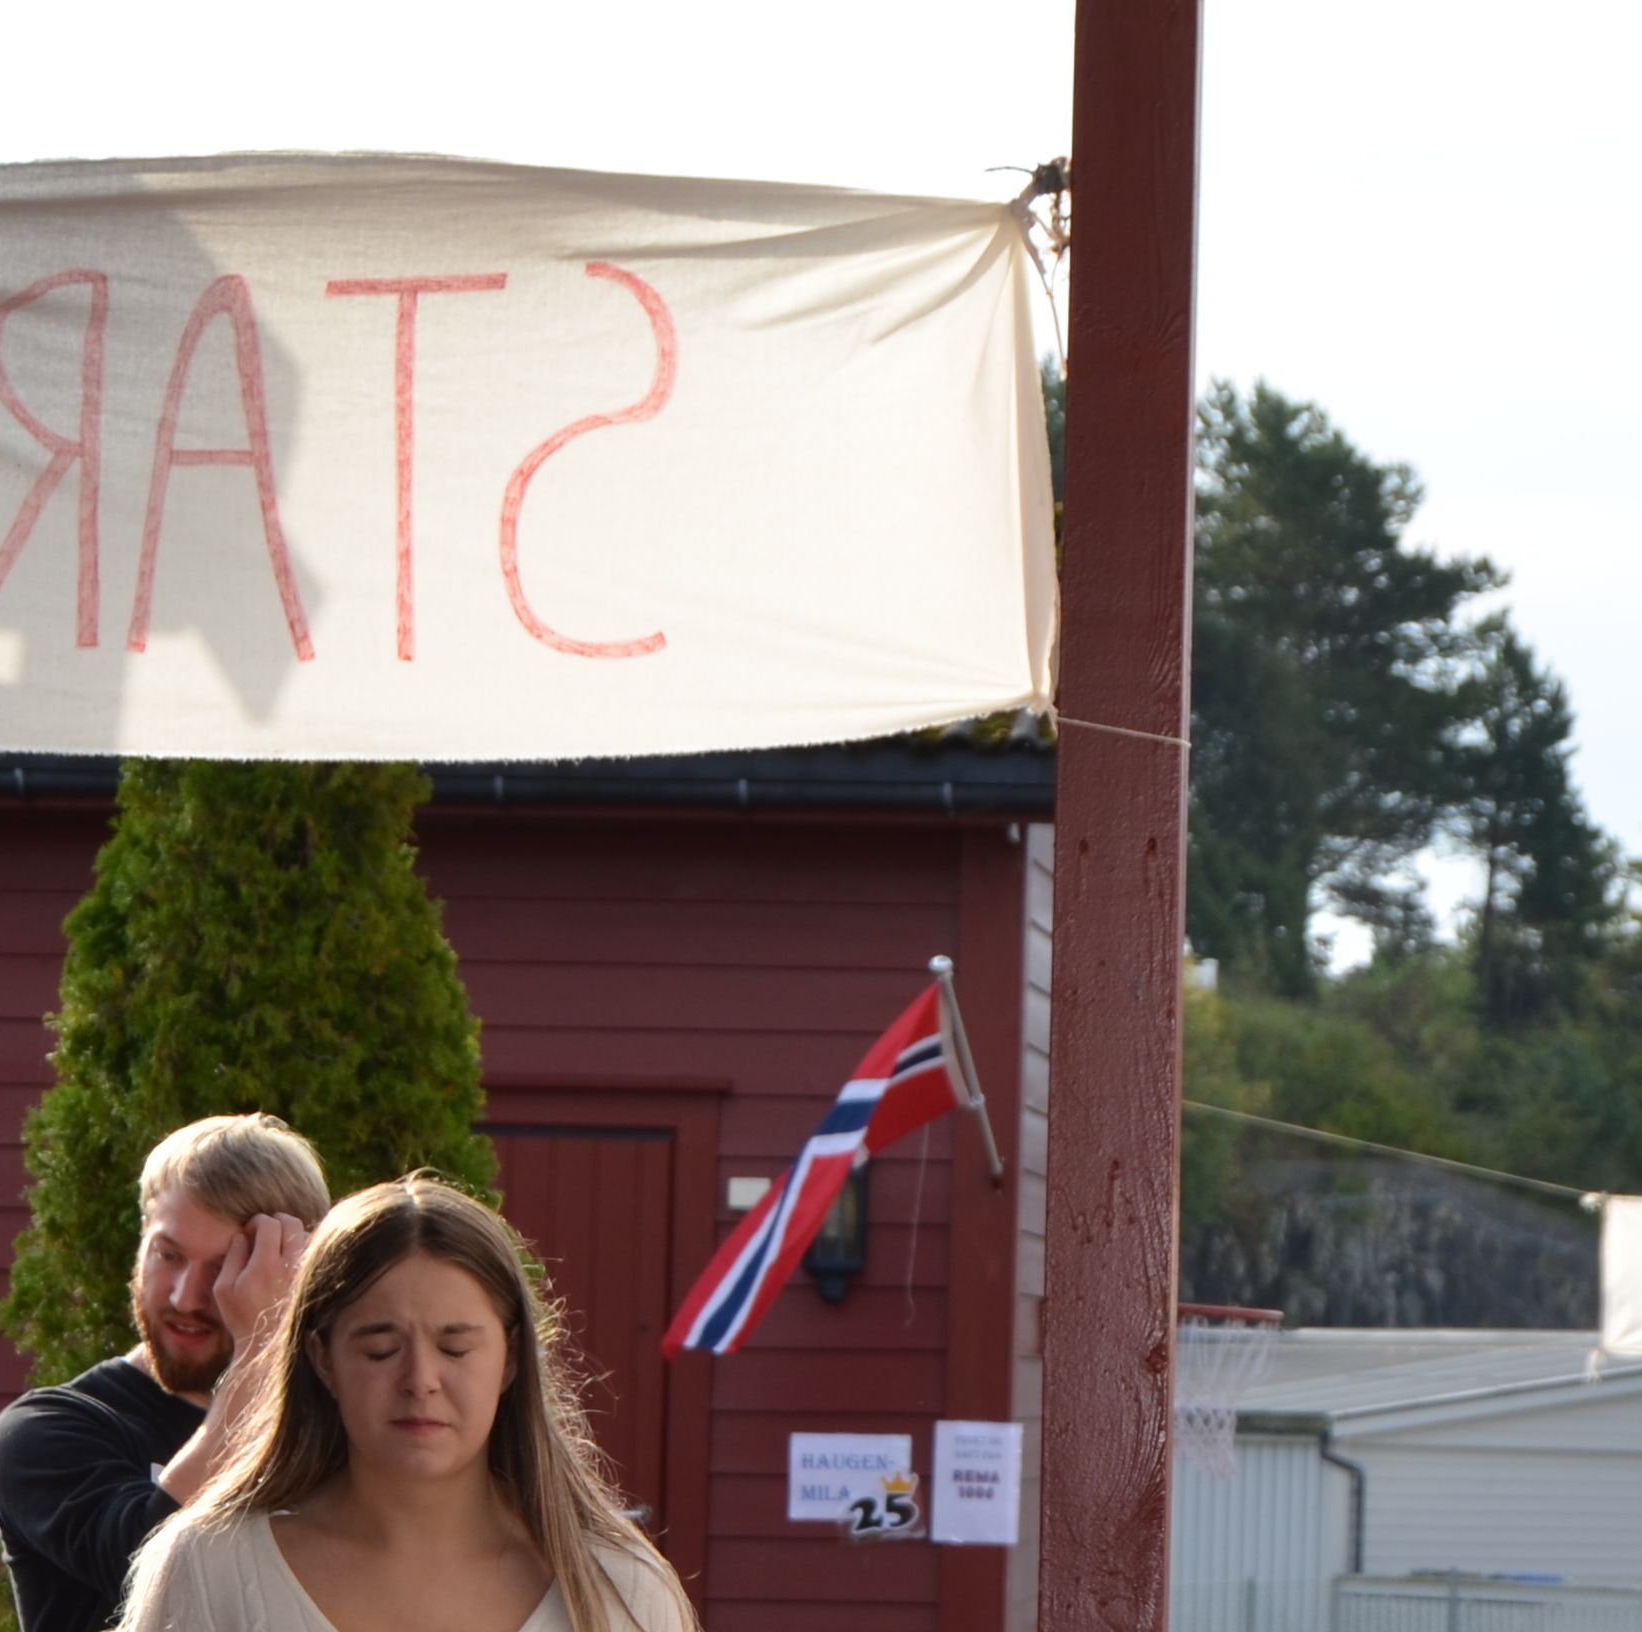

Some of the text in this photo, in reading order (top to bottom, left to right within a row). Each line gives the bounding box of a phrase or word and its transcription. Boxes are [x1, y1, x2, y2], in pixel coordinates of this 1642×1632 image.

[952, 1468, 1000, 1484] REMA
[801, 1484, 850, 1501] MILA
[849, 1492, 916, 1532] 25
